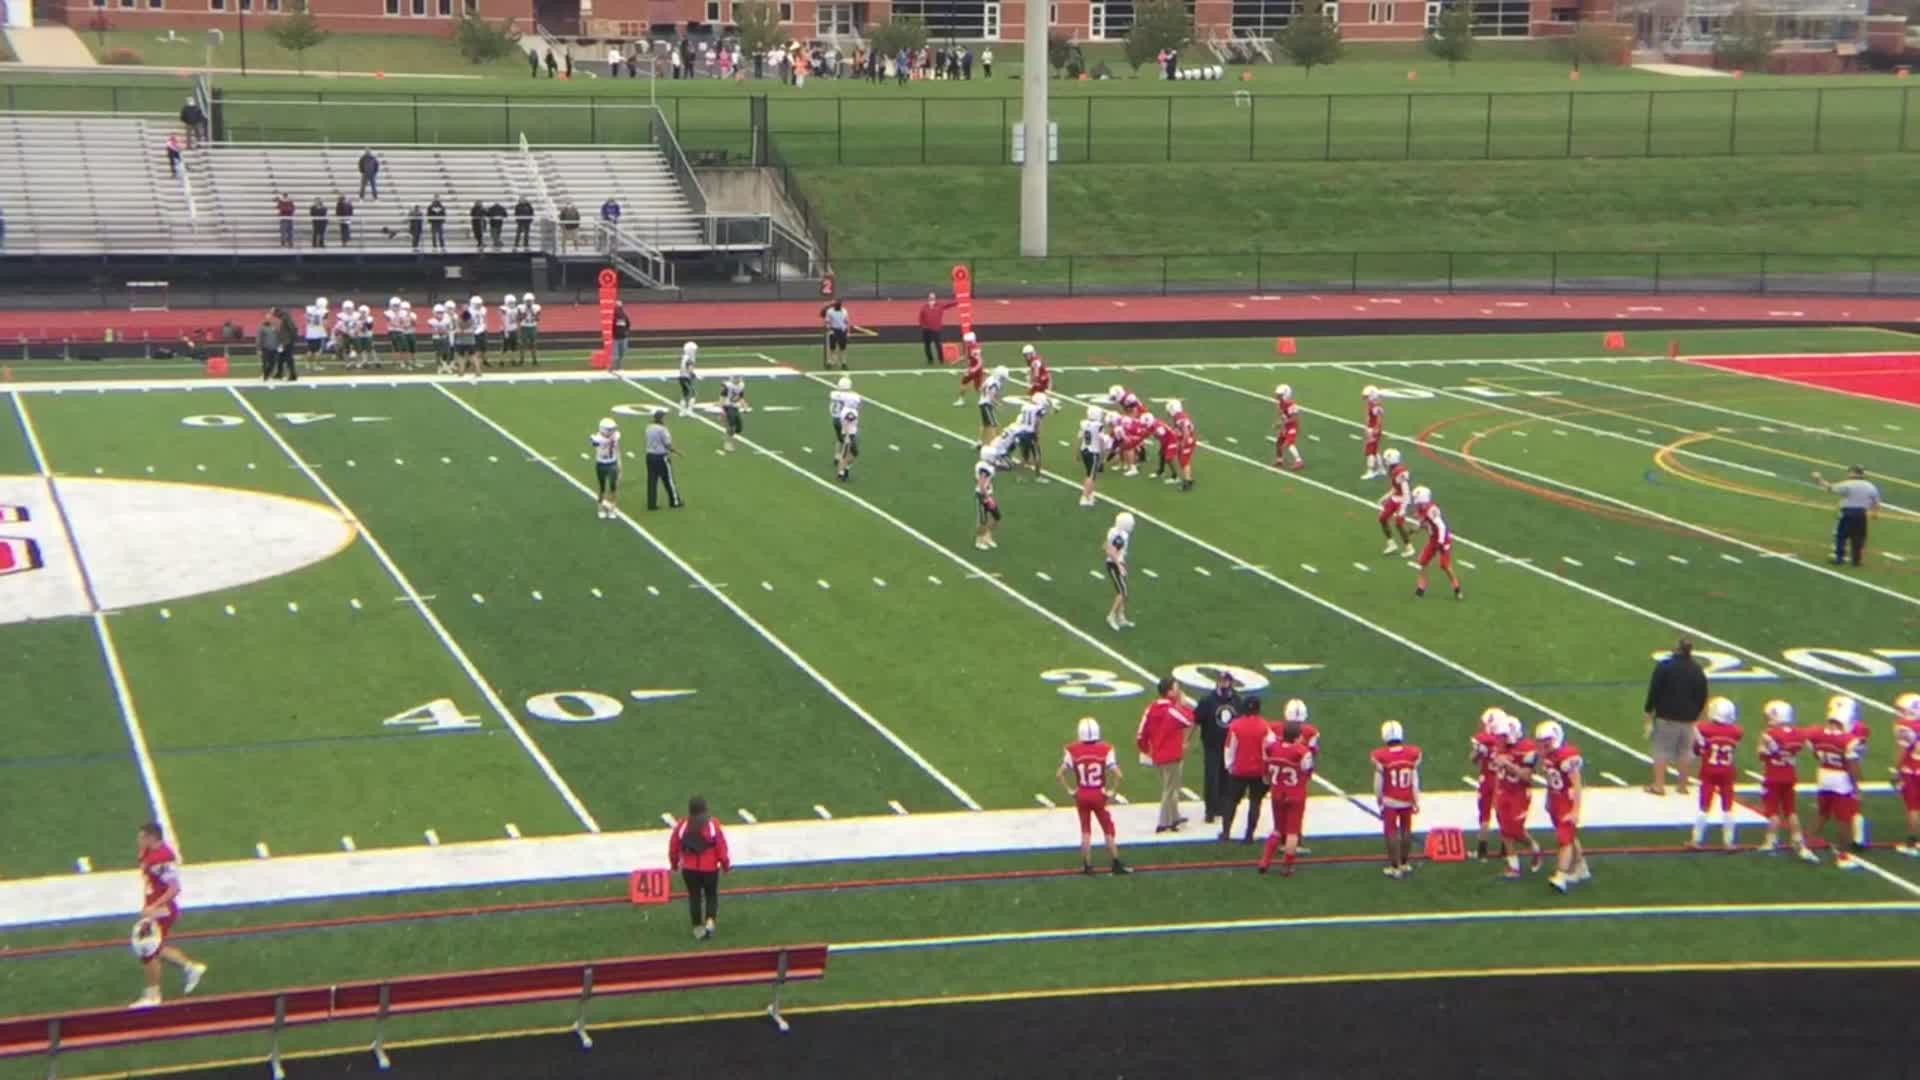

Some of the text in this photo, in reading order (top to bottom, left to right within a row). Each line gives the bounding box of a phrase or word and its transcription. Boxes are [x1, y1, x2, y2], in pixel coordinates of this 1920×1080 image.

[1040, 663, 1270, 698] 30
[383, 690, 623, 732] 40
[1077, 762, 1103, 787] 12
[1268, 764, 1298, 786] 73
[1389, 768, 1412, 788] 10
[1436, 830, 1461, 856] 30
[637, 871, 664, 897] 40
